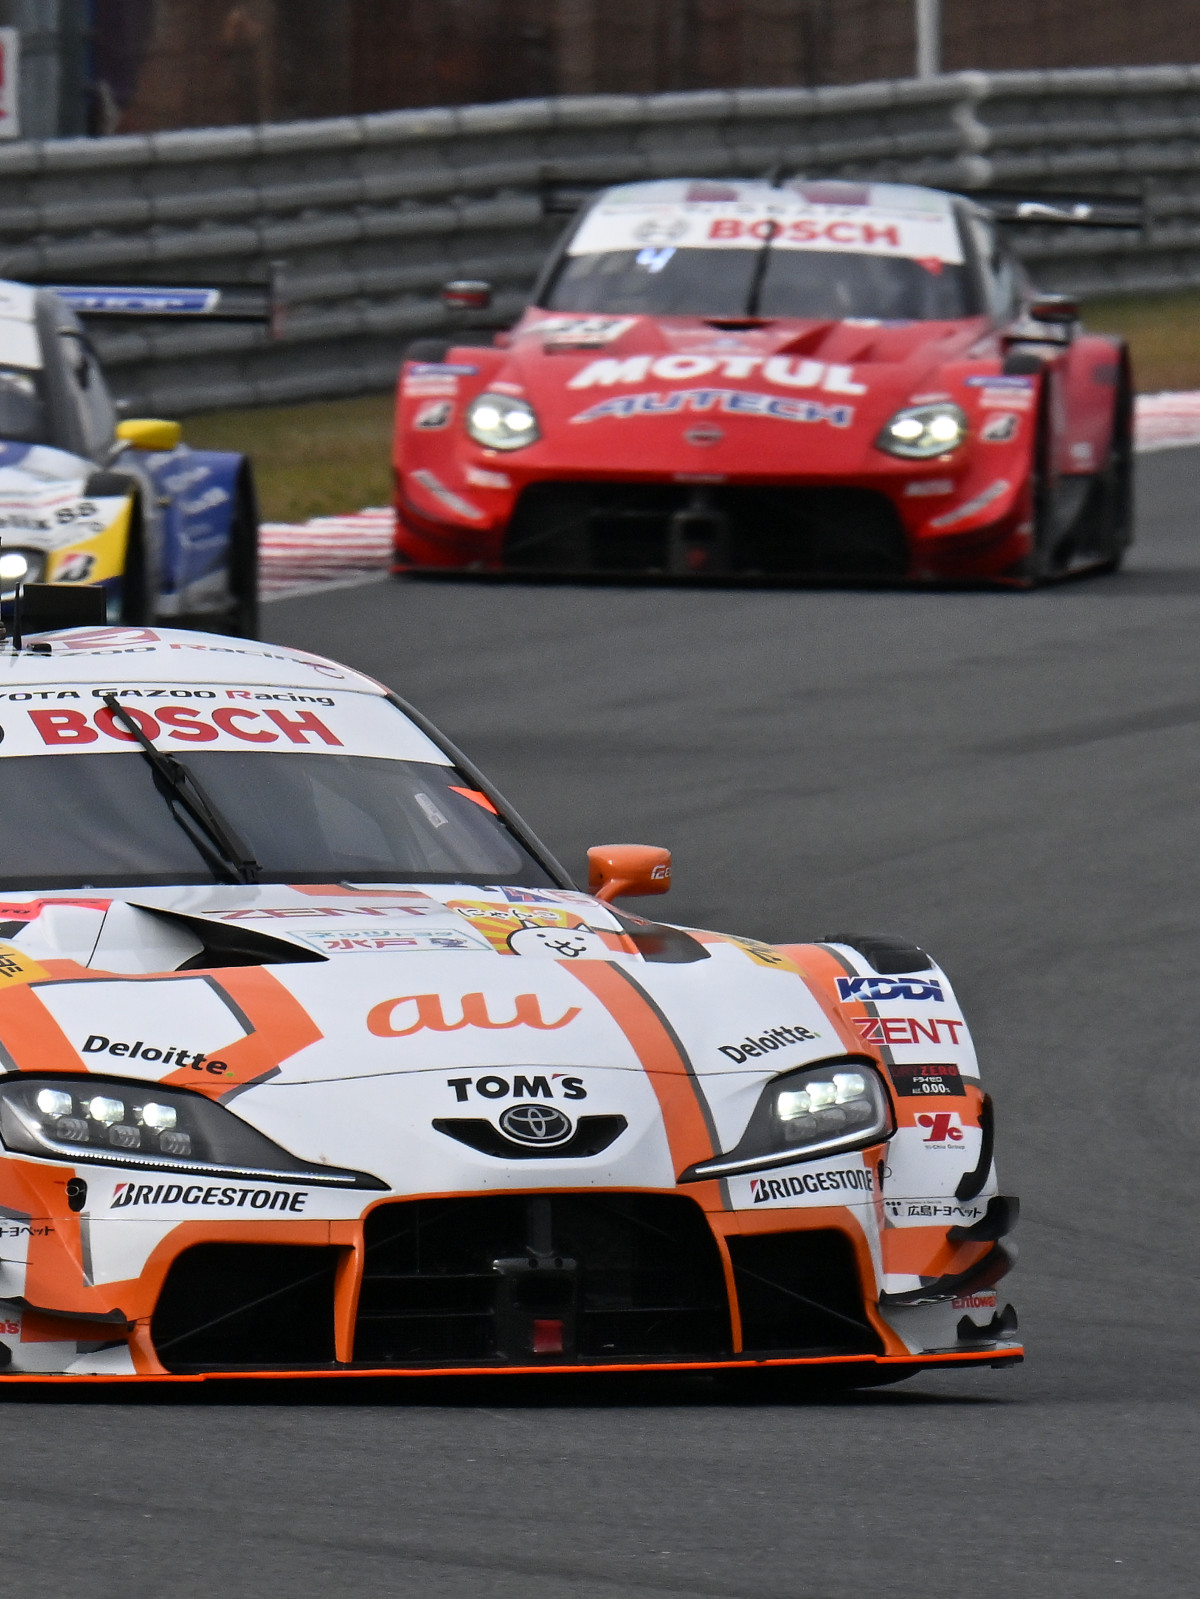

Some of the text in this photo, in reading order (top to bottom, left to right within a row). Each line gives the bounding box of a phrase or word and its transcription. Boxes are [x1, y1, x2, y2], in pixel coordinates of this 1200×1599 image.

[709, 218, 899, 247] BOSCH
[567, 355, 867, 395] MOTUL
[569, 387, 855, 429] AUTECH
[91, 687, 217, 700] GAZOO
[225, 689, 336, 707] Racing
[26, 706, 345, 747] BOSCH
[202, 906, 430, 920] ZENT
[321, 938, 419, 951] 水戸
[837, 977, 945, 1001] KDDI
[366, 991, 582, 1038] au
[718, 1023, 821, 1064] Deloitte.
[851, 1017, 963, 1044] ZENT
[81, 1035, 235, 1076] Deloitte.
[921, 1066, 957, 1076] ZERO
[447, 1073, 587, 1102] TOM'S
[111, 1182, 307, 1212] BRIDGESTONE
[750, 1168, 873, 1203] BRIDGESTONE
[907, 1205, 982, 1218] 広島トヨペット
